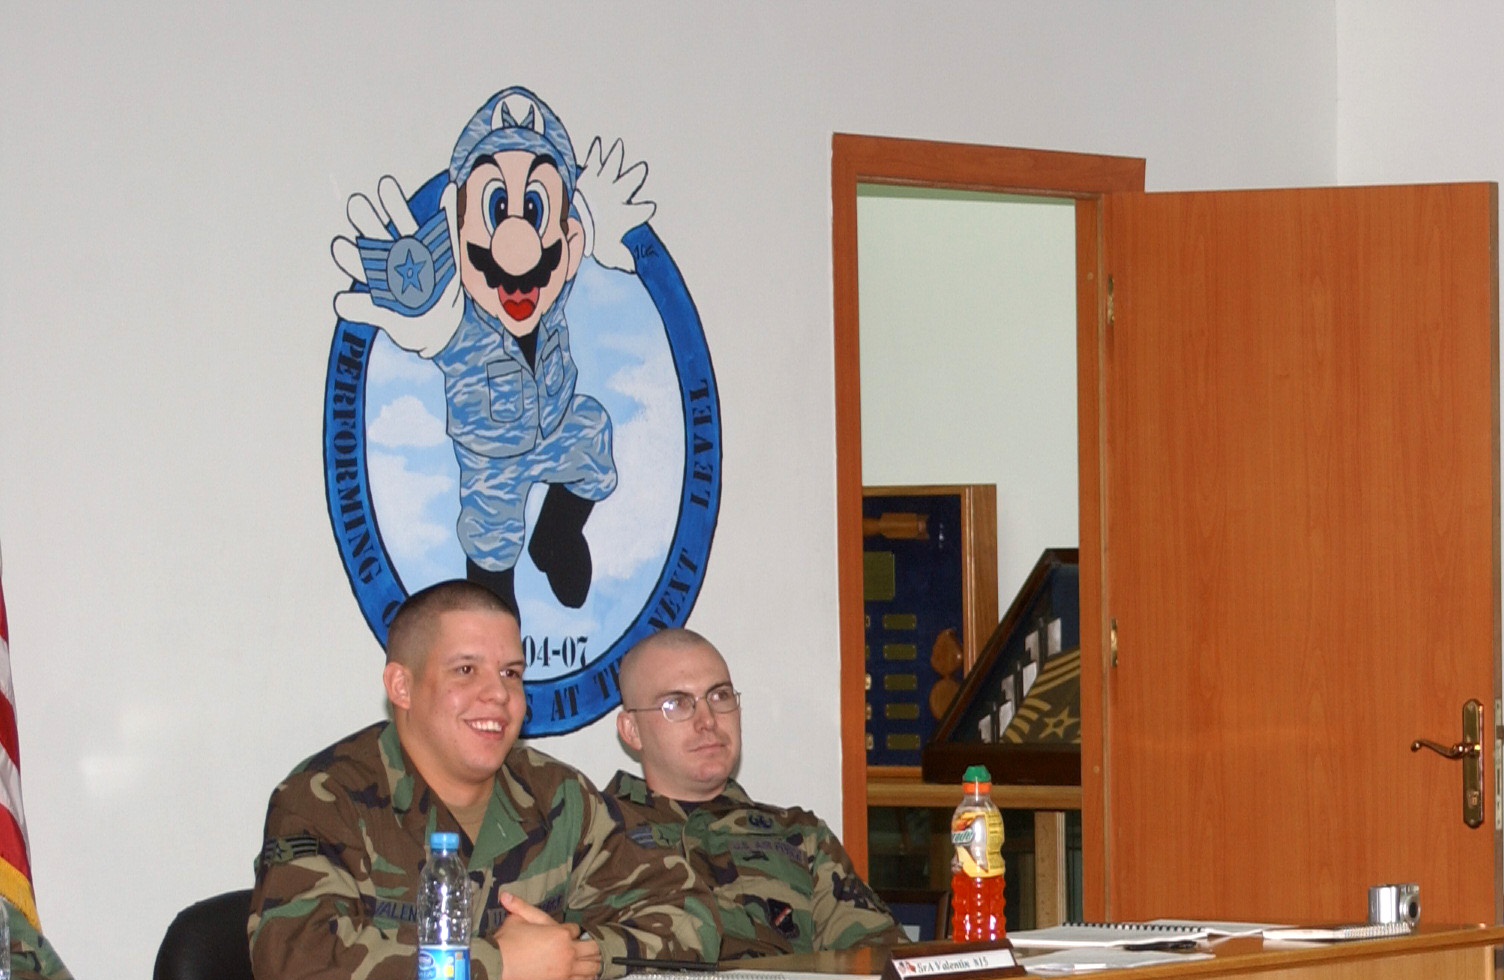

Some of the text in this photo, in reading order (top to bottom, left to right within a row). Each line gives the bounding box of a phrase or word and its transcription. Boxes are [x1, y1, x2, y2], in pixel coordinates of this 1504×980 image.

[333, 328, 383, 585] PERFORMING
[551, 684, 579, 721] AT
[690, 378, 713, 510] LEVEL
